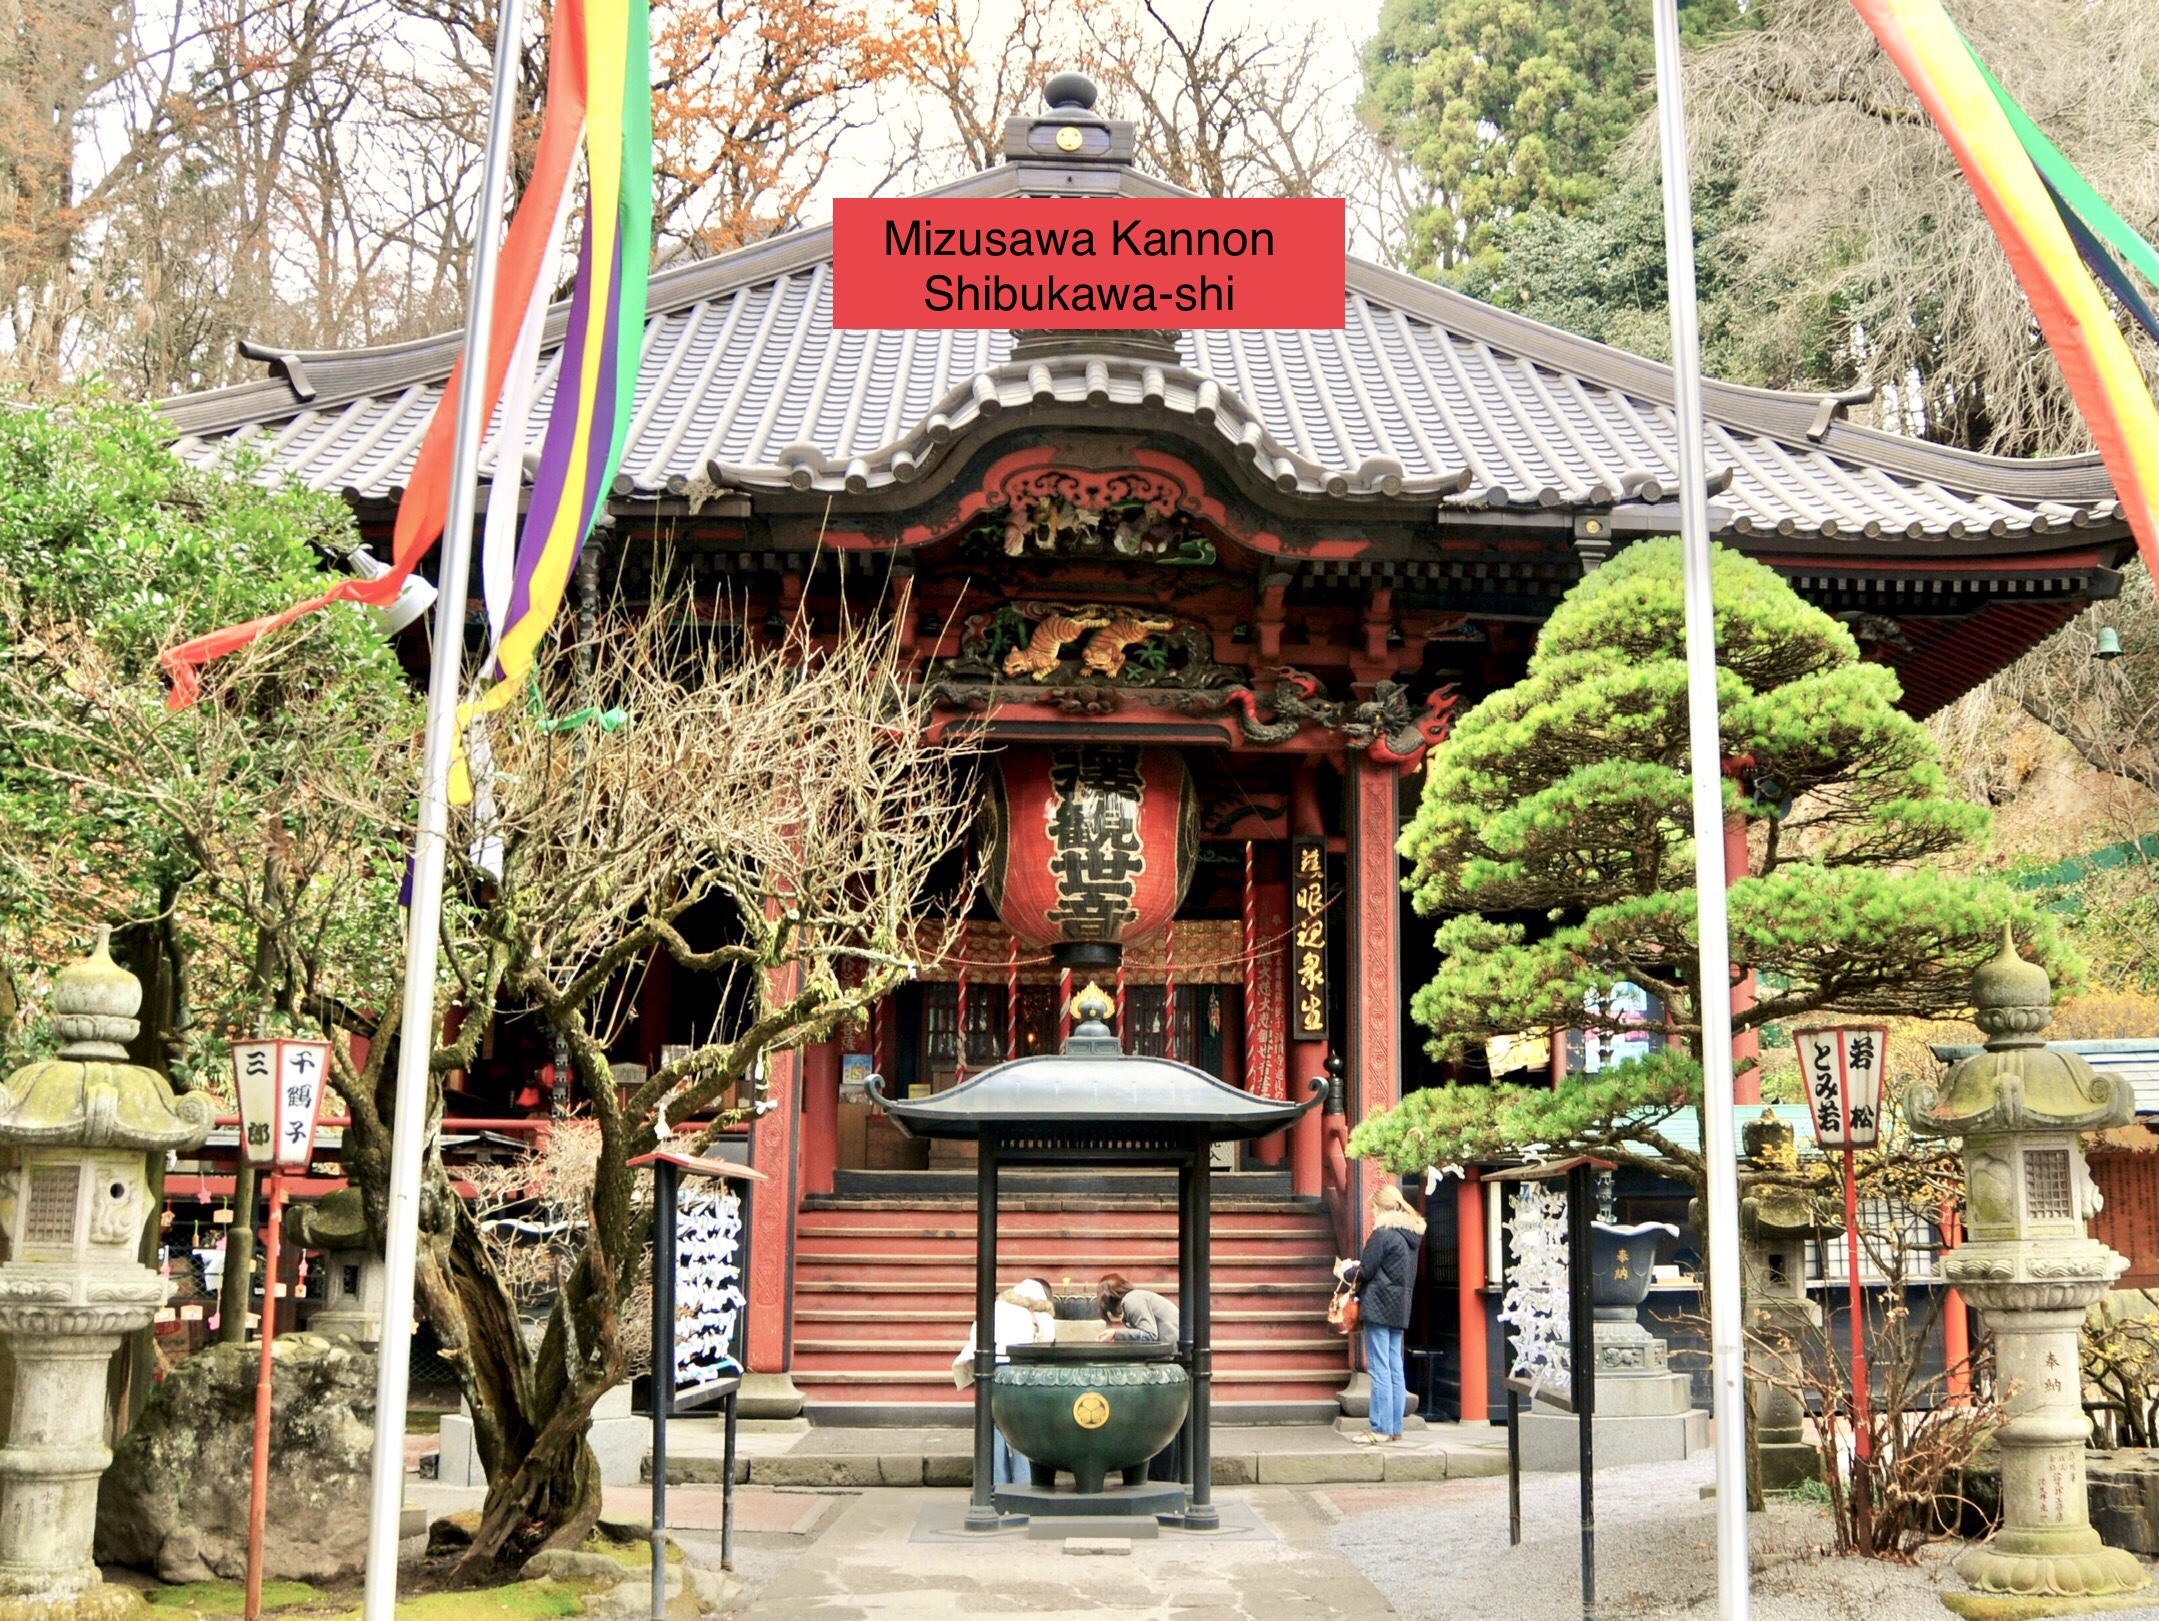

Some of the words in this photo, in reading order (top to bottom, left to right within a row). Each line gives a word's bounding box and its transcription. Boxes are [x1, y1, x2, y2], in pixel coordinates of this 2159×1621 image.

[246, 1051, 270, 1146] 三郎
[285, 1050, 315, 1144] 千鶴子
[1814, 1041, 1841, 1132] とみ若
[1849, 1036, 1875, 1130] 若松
[2044, 1350, 2062, 1393] 奉納
